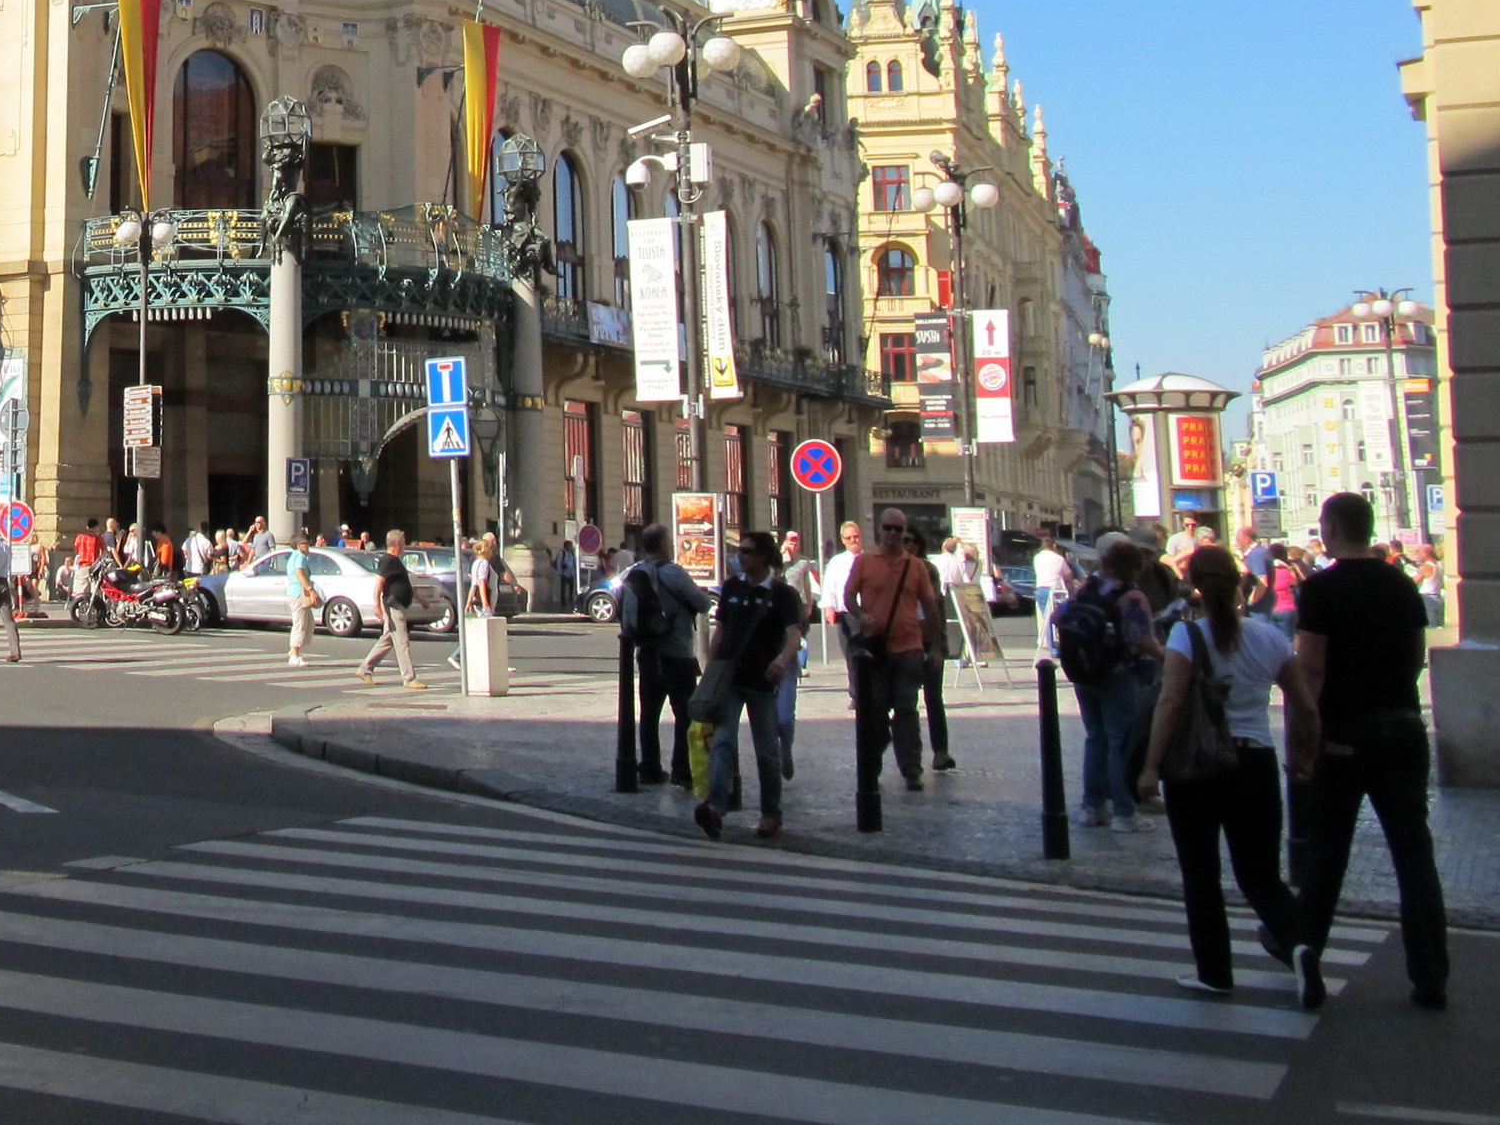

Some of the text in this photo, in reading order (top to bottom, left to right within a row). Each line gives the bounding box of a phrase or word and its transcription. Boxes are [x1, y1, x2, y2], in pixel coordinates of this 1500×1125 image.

[639, 286, 668, 300] KOALA
[291, 462, 304, 483] P
[873, 487, 941, 498] RESTAURANT
[1256, 474, 1271, 495] P
[1433, 488, 1443, 504] P
